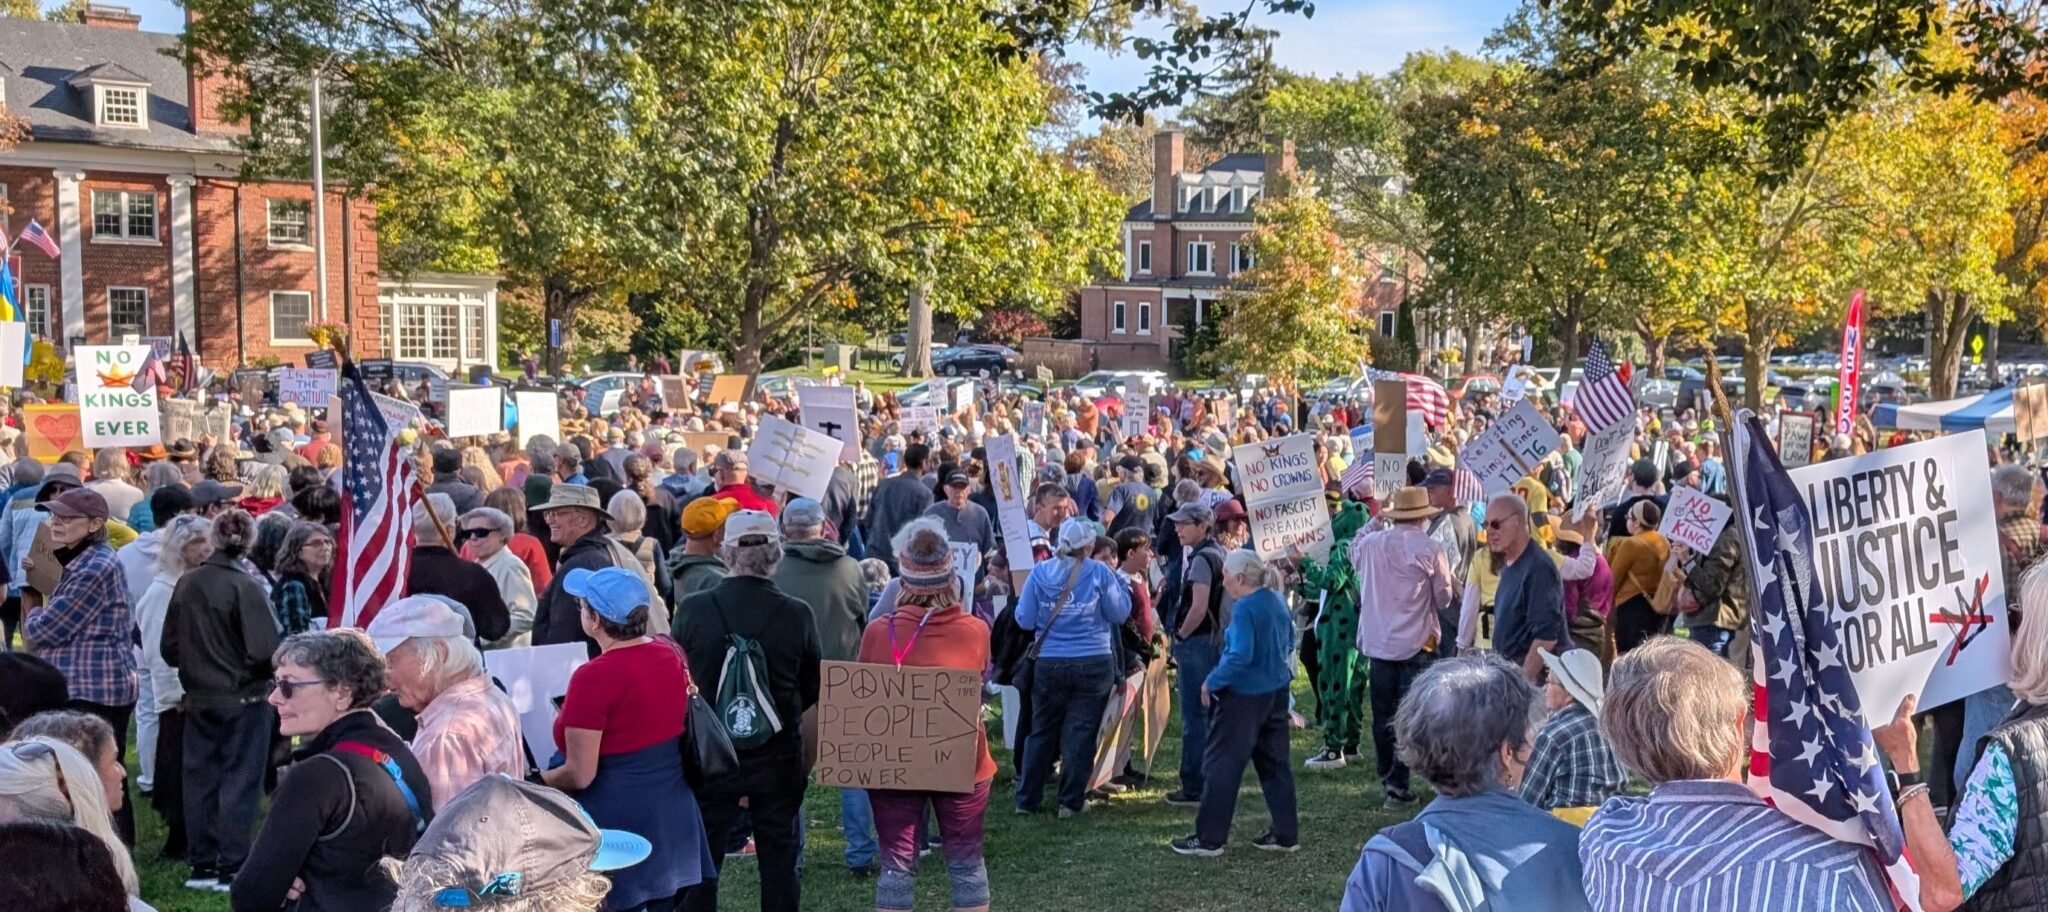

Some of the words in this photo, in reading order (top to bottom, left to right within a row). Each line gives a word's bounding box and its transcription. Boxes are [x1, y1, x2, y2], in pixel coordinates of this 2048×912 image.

[96, 350, 131, 364] NO
[296, 380, 319, 389] THE
[84, 393, 152, 407] KINGS
[94, 420, 149, 436] EVER
[1511, 424, 1539, 448] Since
[1784, 430, 1808, 441] PAW
[1461, 414, 1527, 467] Resisting
[1245, 460, 1265, 476] NO
[1269, 451, 1308, 470] KINGS
[1784, 449, 1808, 461] LAW
[1382, 459, 1400, 473] NO
[1250, 478, 1269, 493] NO
[1272, 468, 1312, 489] CROWNS
[1375, 480, 1403, 493] KINGS
[1685, 496, 1712, 515] NO
[1808, 461, 1916, 538] LIBERTY
[1924, 457, 1947, 511] &
[1255, 506, 1272, 521] NO
[1275, 496, 1318, 518] FASCIST
[1671, 519, 1713, 552] KINGS
[1818, 509, 1965, 614] JUSTICE
[1891, 596, 1938, 661] ALL
[825, 665, 951, 703] POWER
[959, 675, 977, 684] OF
[956, 687, 977, 697] THE
[820, 704, 942, 738] PEOPLE
[820, 740, 913, 763] PEOPLE
[934, 749, 953, 764] IN
[818, 766, 907, 785] POWER
